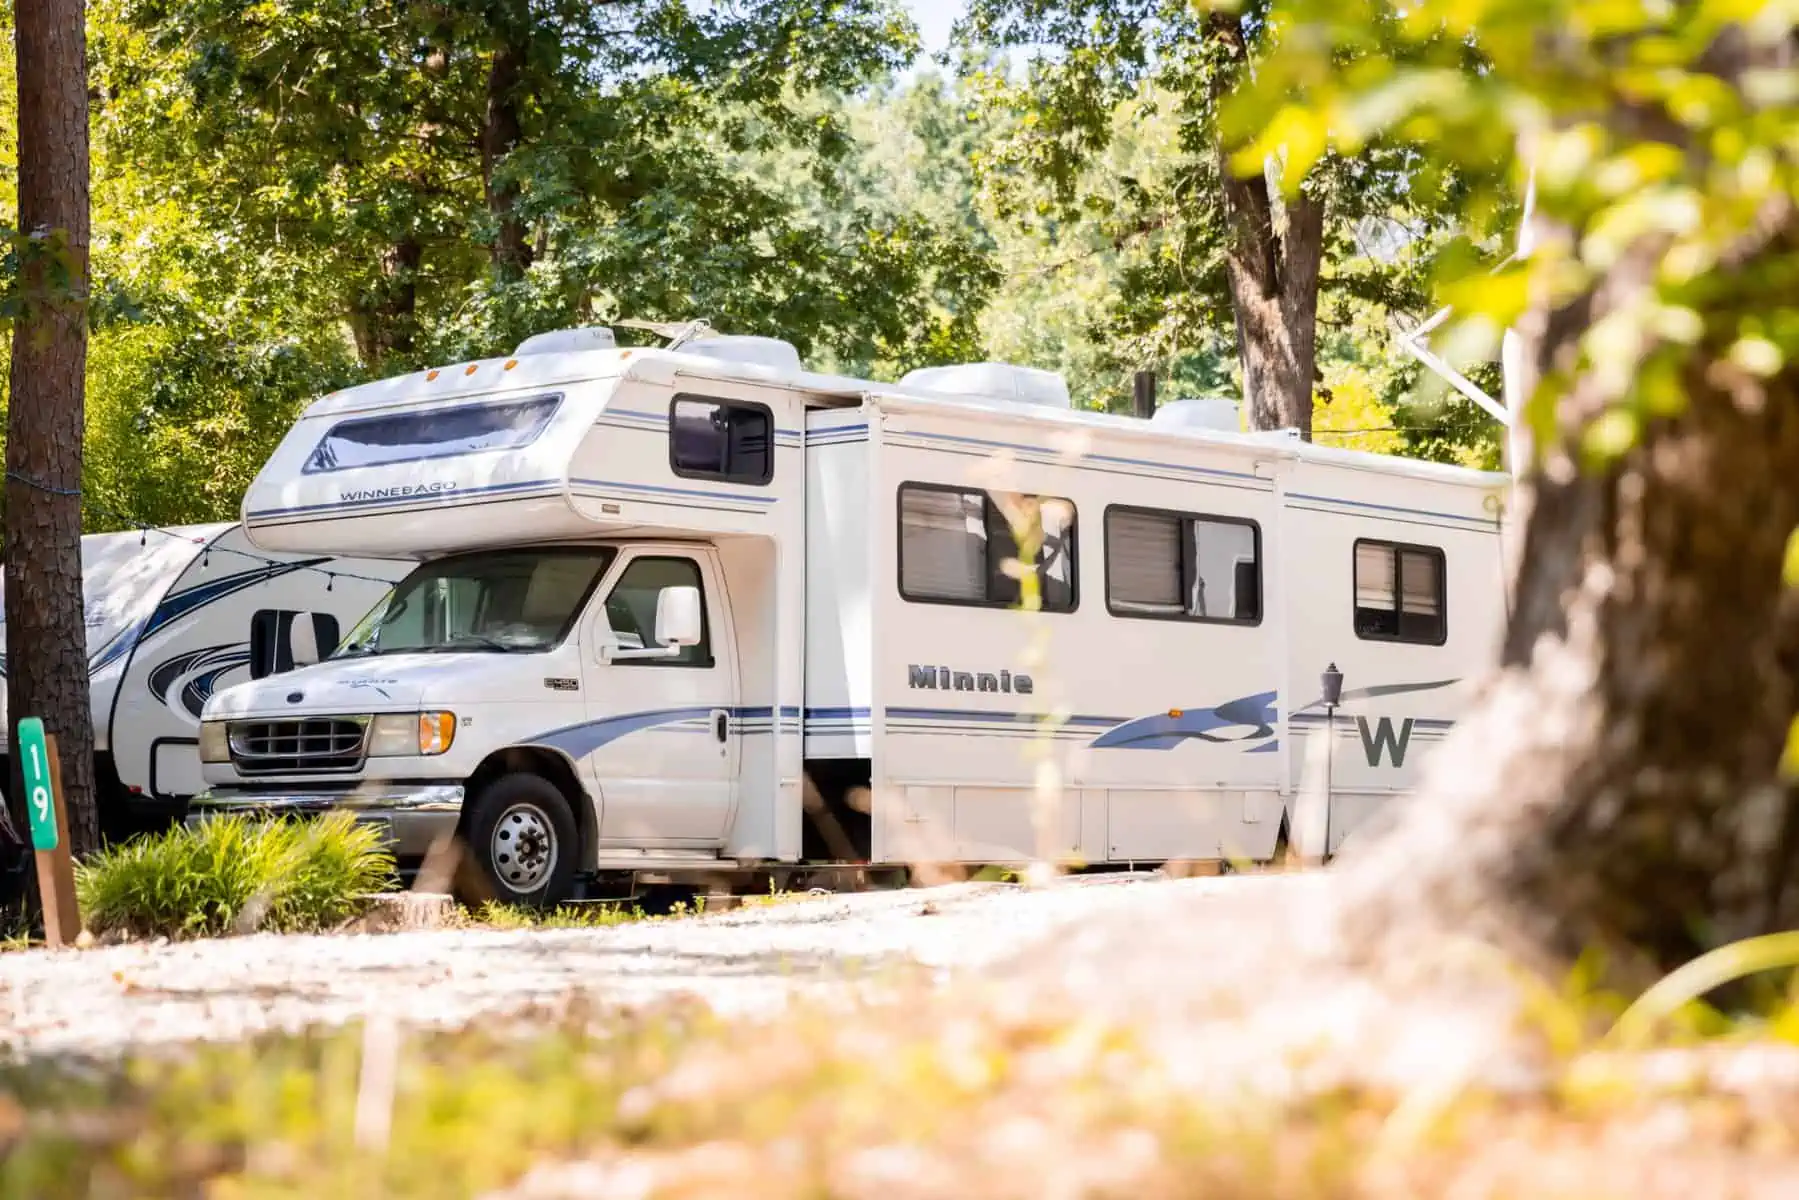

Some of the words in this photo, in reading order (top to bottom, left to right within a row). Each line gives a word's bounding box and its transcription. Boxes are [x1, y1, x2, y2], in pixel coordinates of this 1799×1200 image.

[340, 481, 457, 501] WINNEBAGO
[907, 663, 1033, 694] Minnie
[1356, 715, 1414, 768] W
[30, 743, 49, 823] 19
